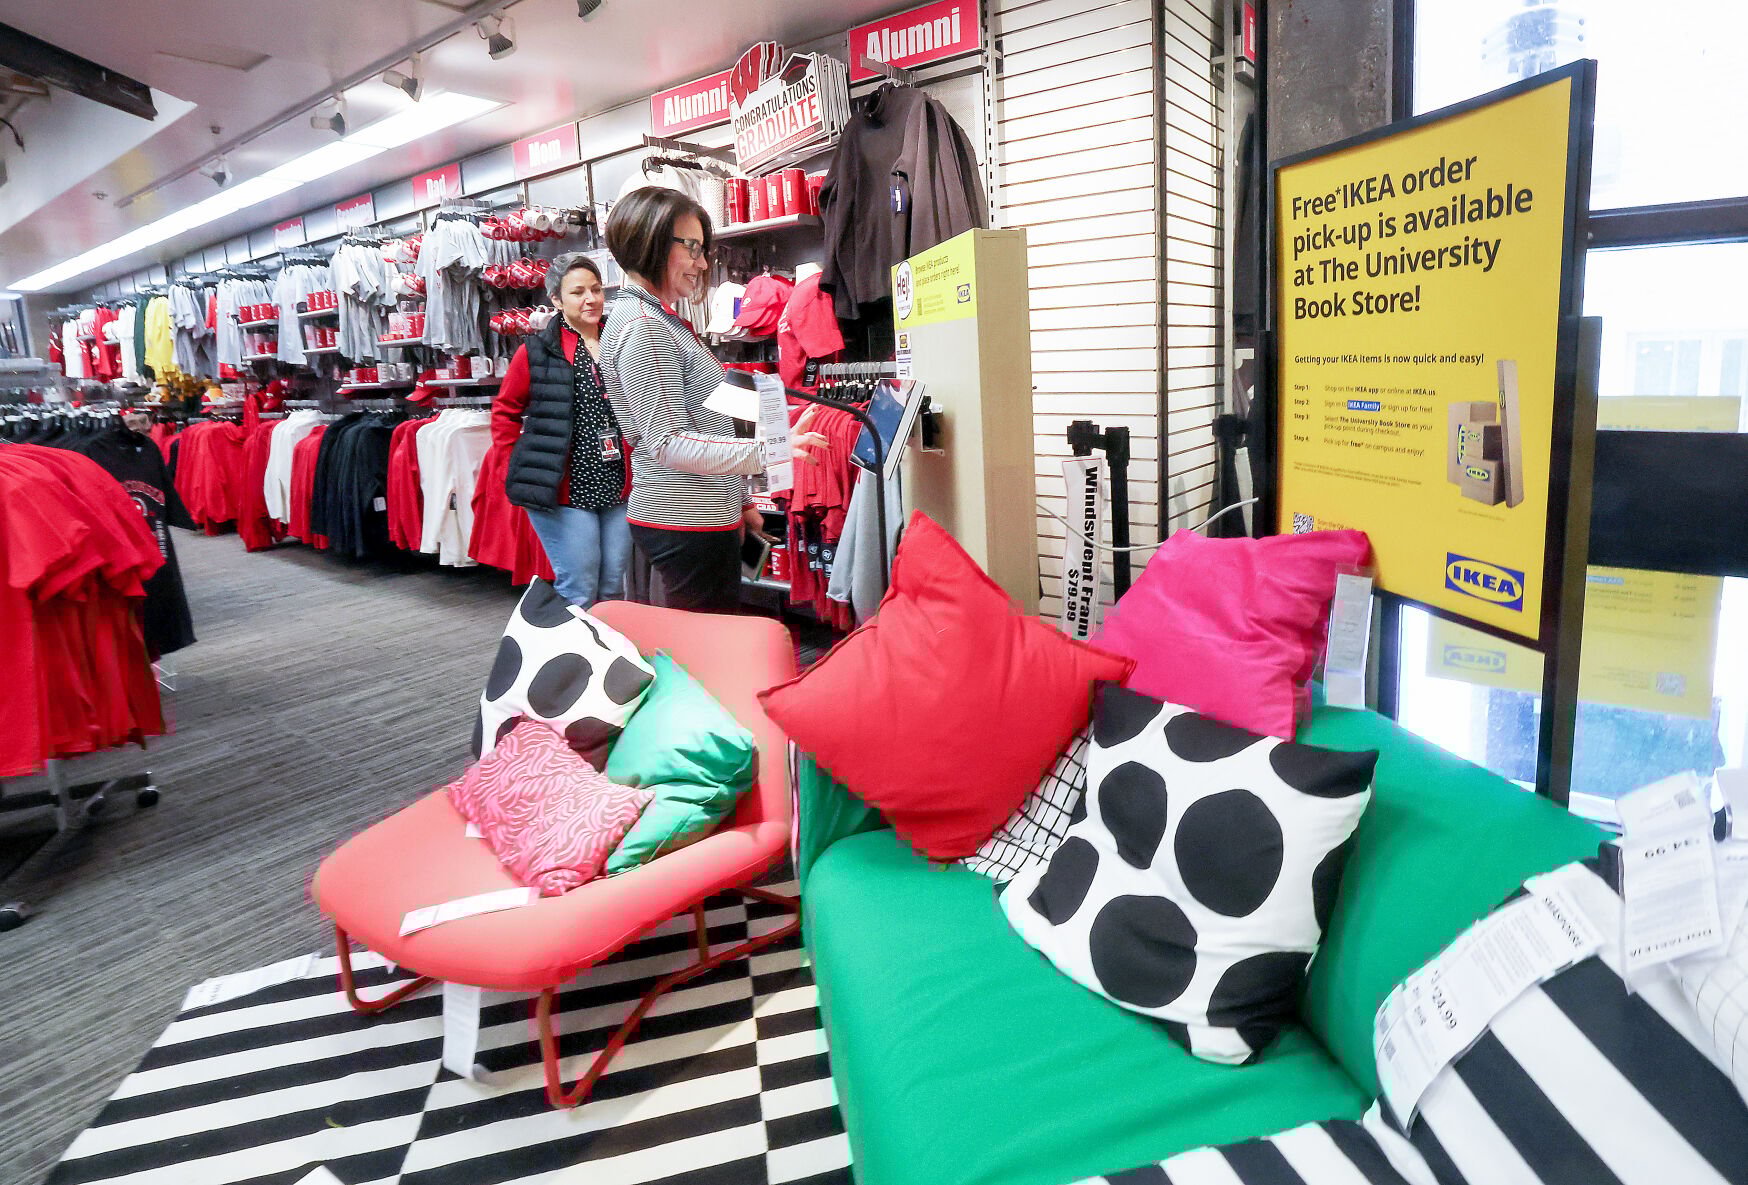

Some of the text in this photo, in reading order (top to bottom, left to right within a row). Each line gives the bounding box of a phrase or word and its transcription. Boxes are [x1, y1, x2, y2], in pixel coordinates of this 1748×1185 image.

[866, 7, 961, 63] Alumni
[663, 81, 728, 127] Alumni
[734, 74, 816, 135] CONGRATULATIONS
[737, 93, 820, 161] GRADUATE
[1343, 173, 1396, 209] IKEA
[1402, 156, 1478, 195] order
[1293, 183, 1533, 261] pick-up is available
[1293, 236, 1501, 287] at The University
[1294, 285, 1421, 320] Book Store!
[1294, 353, 1484, 366] Getting your IKEA items is now quick and easy!
[1350, 416, 1378, 427] University
[1395, 421, 1410, 429] Store
[1361, 402, 1380, 411] Family
[1067, 569, 1080, 622] $79.99
[1453, 565, 1518, 598] IKEA
